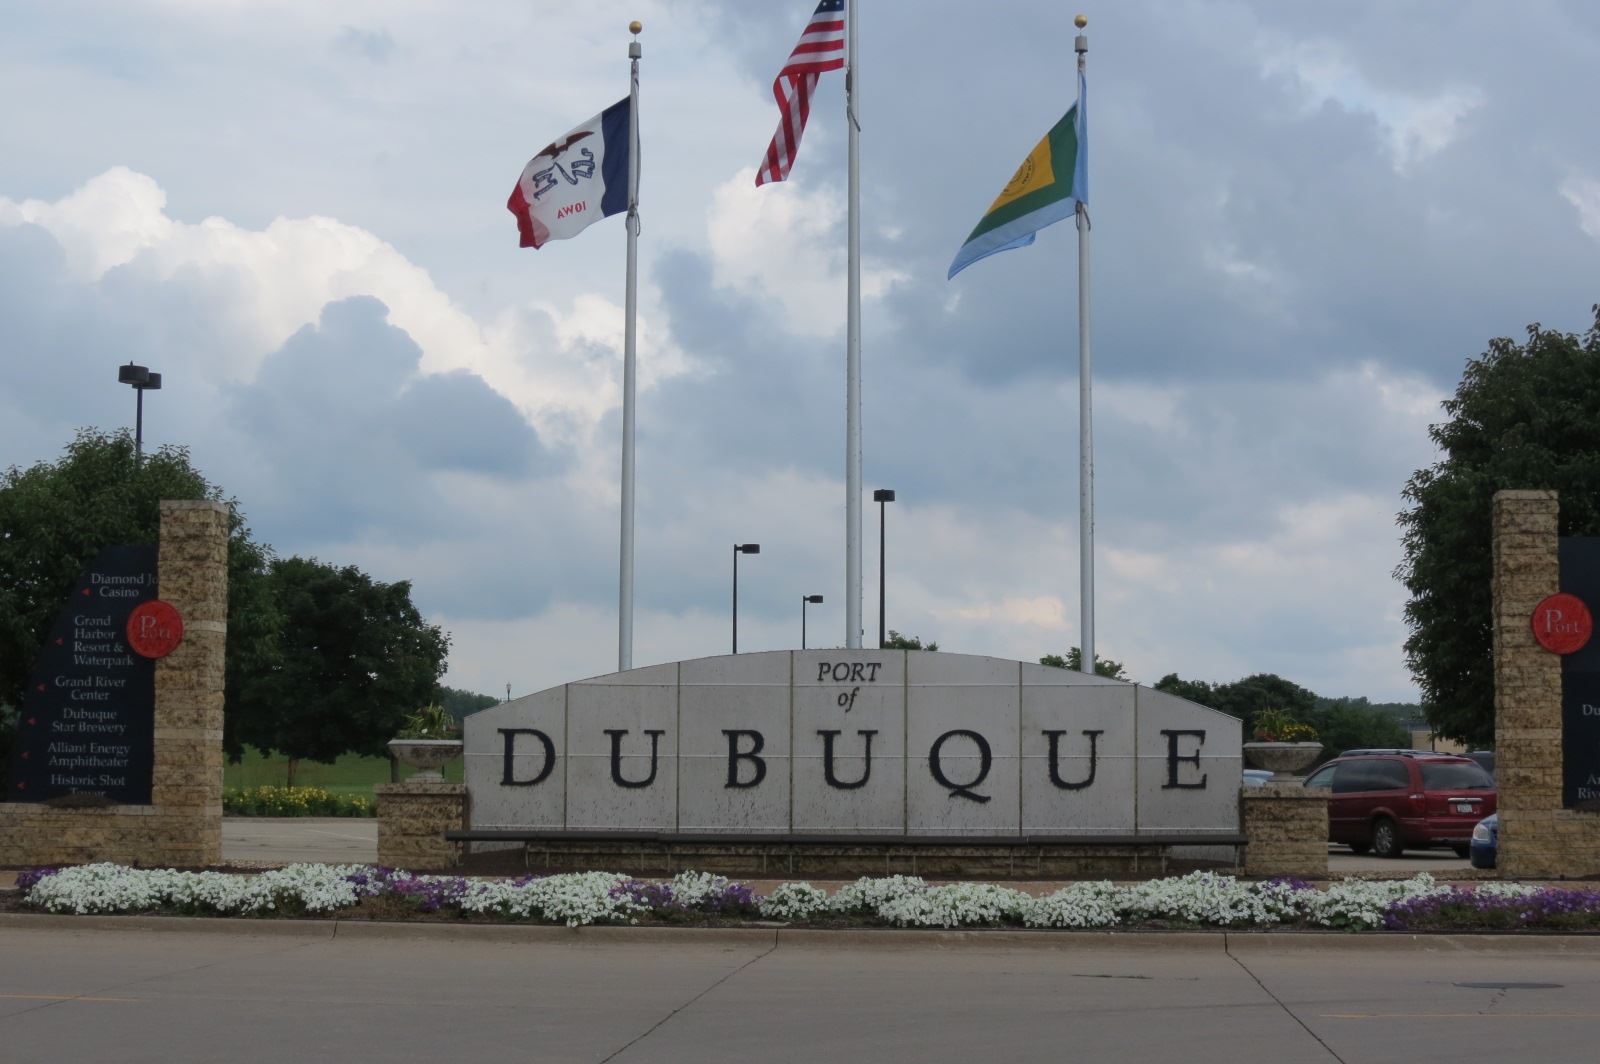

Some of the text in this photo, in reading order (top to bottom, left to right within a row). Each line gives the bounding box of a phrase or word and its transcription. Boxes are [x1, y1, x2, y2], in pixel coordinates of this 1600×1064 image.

[91, 573, 144, 585] Diamond
[99, 586, 140, 598] Casino
[74, 615, 111, 626] Grand
[1544, 609, 1581, 634] Port
[74, 627, 117, 639] Harbor
[74, 641, 124, 653] Resort &
[73, 654, 135, 669] Waterpark
[817, 662, 882, 682] PORT
[55, 675, 126, 687] Grand River
[71, 689, 111, 700] Center
[837, 686, 860, 713] of
[63, 707, 117, 722] Dubuque
[52, 721, 127, 735] Star Brewery
[47, 742, 131, 756] Alliant Energy
[48, 755, 129, 769] Amphitheater
[497, 728, 1207, 803] DUBUQUE
[51, 774, 126, 786] Historic Shot
